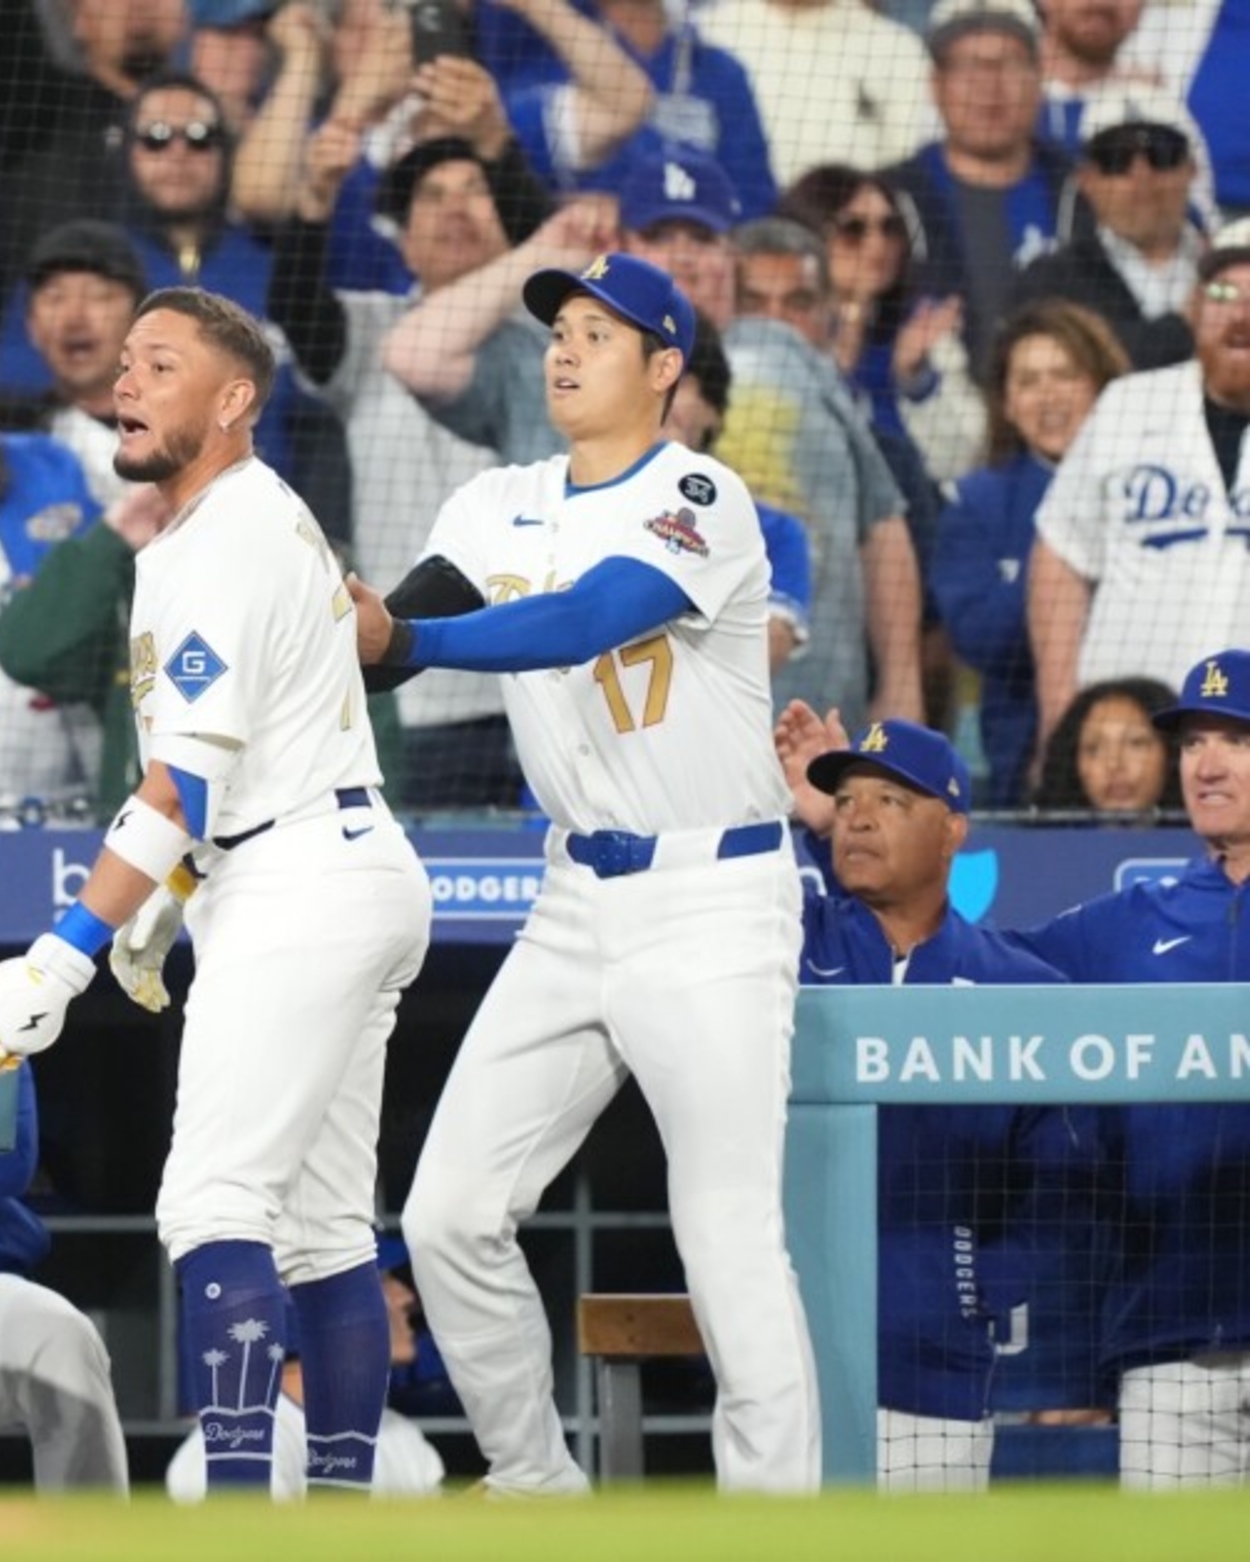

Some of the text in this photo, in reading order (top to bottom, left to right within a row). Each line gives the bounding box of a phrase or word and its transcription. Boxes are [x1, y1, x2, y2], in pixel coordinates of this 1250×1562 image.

[182, 650, 206, 674] G
[1200, 661, 1229, 698] LA
[593, 634, 673, 734] 17
[856, 1035, 1046, 1083] BANK
[1069, 1034, 1155, 1081] OF
[953, 1225, 978, 1319] DODGERS
[205, 1422, 265, 1449] Dodgers
